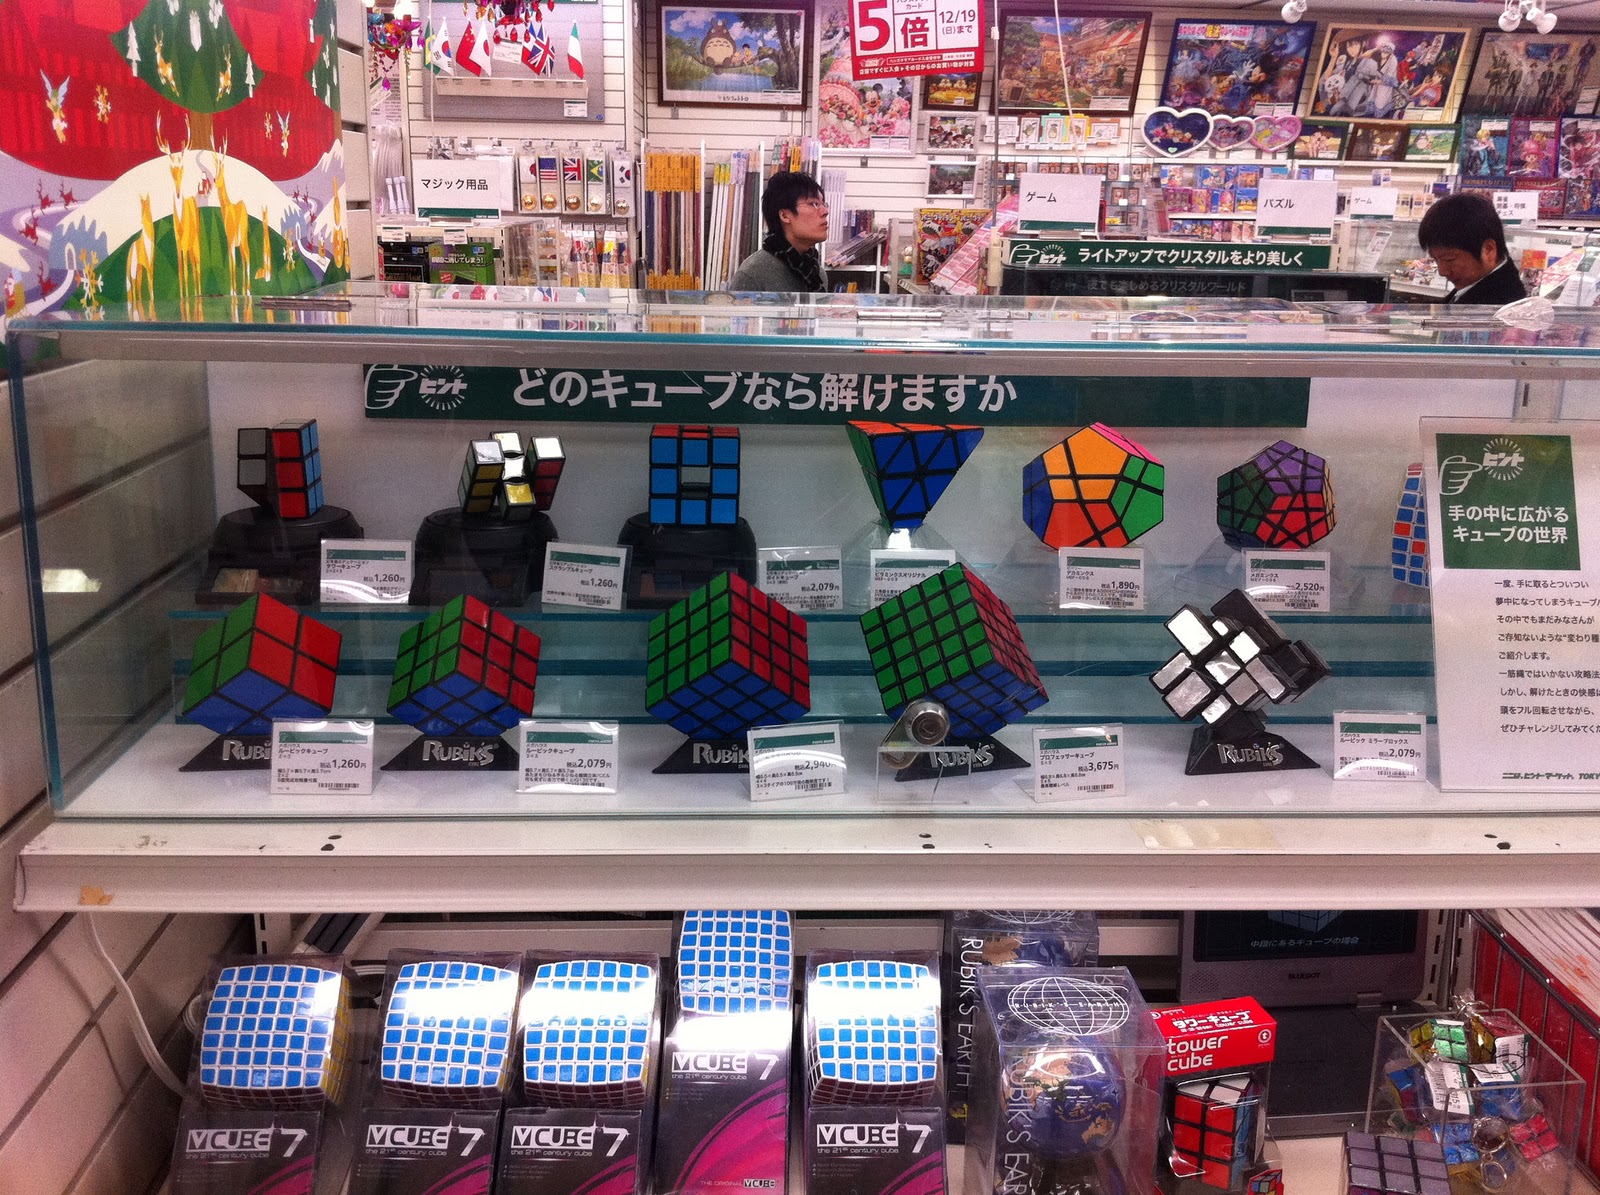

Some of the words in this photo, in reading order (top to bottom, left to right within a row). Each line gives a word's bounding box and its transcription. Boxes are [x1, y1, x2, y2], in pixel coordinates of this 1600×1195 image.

[858, 0, 891, 51] 5
[939, 9, 976, 24] 12/19
[900, 17, 929, 49] 倍
[421, 179, 489, 191] マジック用品
[1026, 191, 1057, 203] ゲーム
[1263, 198, 1295, 210] パズル
[1078, 247, 1303, 267] ライトアップでクリスタルをより美しく
[513, 368, 1017, 413] どのキューブなら解けますか
[1448, 505, 1569, 523] 手の中に広がる
[1453, 526, 1568, 544] キューブの世界
[1494, 579, 1589, 588] 一度、手に取るとついつい
[1496, 615, 1595, 624] その中でもまだみなさんが
[1498, 651, 1550, 660] ご紹介します。
[1500, 705, 1595, 715] 頭をフル回転させながら、
[959, 938, 983, 1016] RUBIK'S
[1172, 1010, 1251, 1029] タワーキューブ
[1167, 1036, 1228, 1055] tower
[754, 1053, 780, 1080] 7
[1167, 1053, 1213, 1071] cube
[1005, 1056, 1035, 1143] RUBIK'S
[281, 1127, 308, 1157] 7
[459, 1126, 486, 1156] 7
[602, 1126, 630, 1156] 7
[906, 1124, 933, 1153] 7
